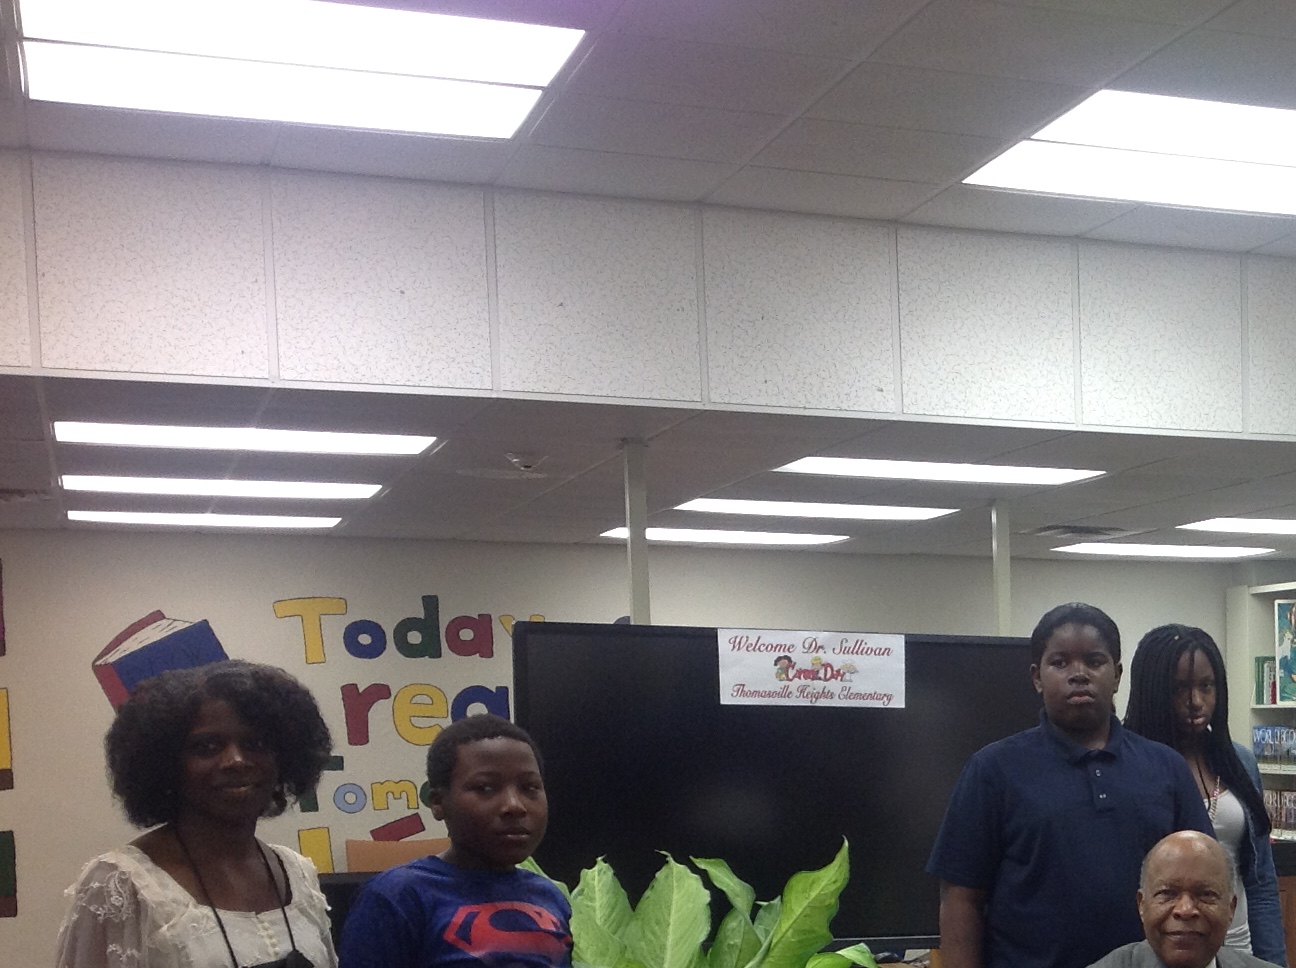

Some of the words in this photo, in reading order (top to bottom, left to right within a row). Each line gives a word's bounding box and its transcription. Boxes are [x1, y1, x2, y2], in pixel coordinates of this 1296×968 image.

[273, 594, 546, 664] Toda
[728, 635, 797, 654] Welcome
[802, 636, 827, 655] Dr.
[832, 637, 894, 657] Sullivan
[730, 683, 794, 699] Thomasville
[795, 684, 836, 705] Heights
[837, 685, 895, 706] Elementary
